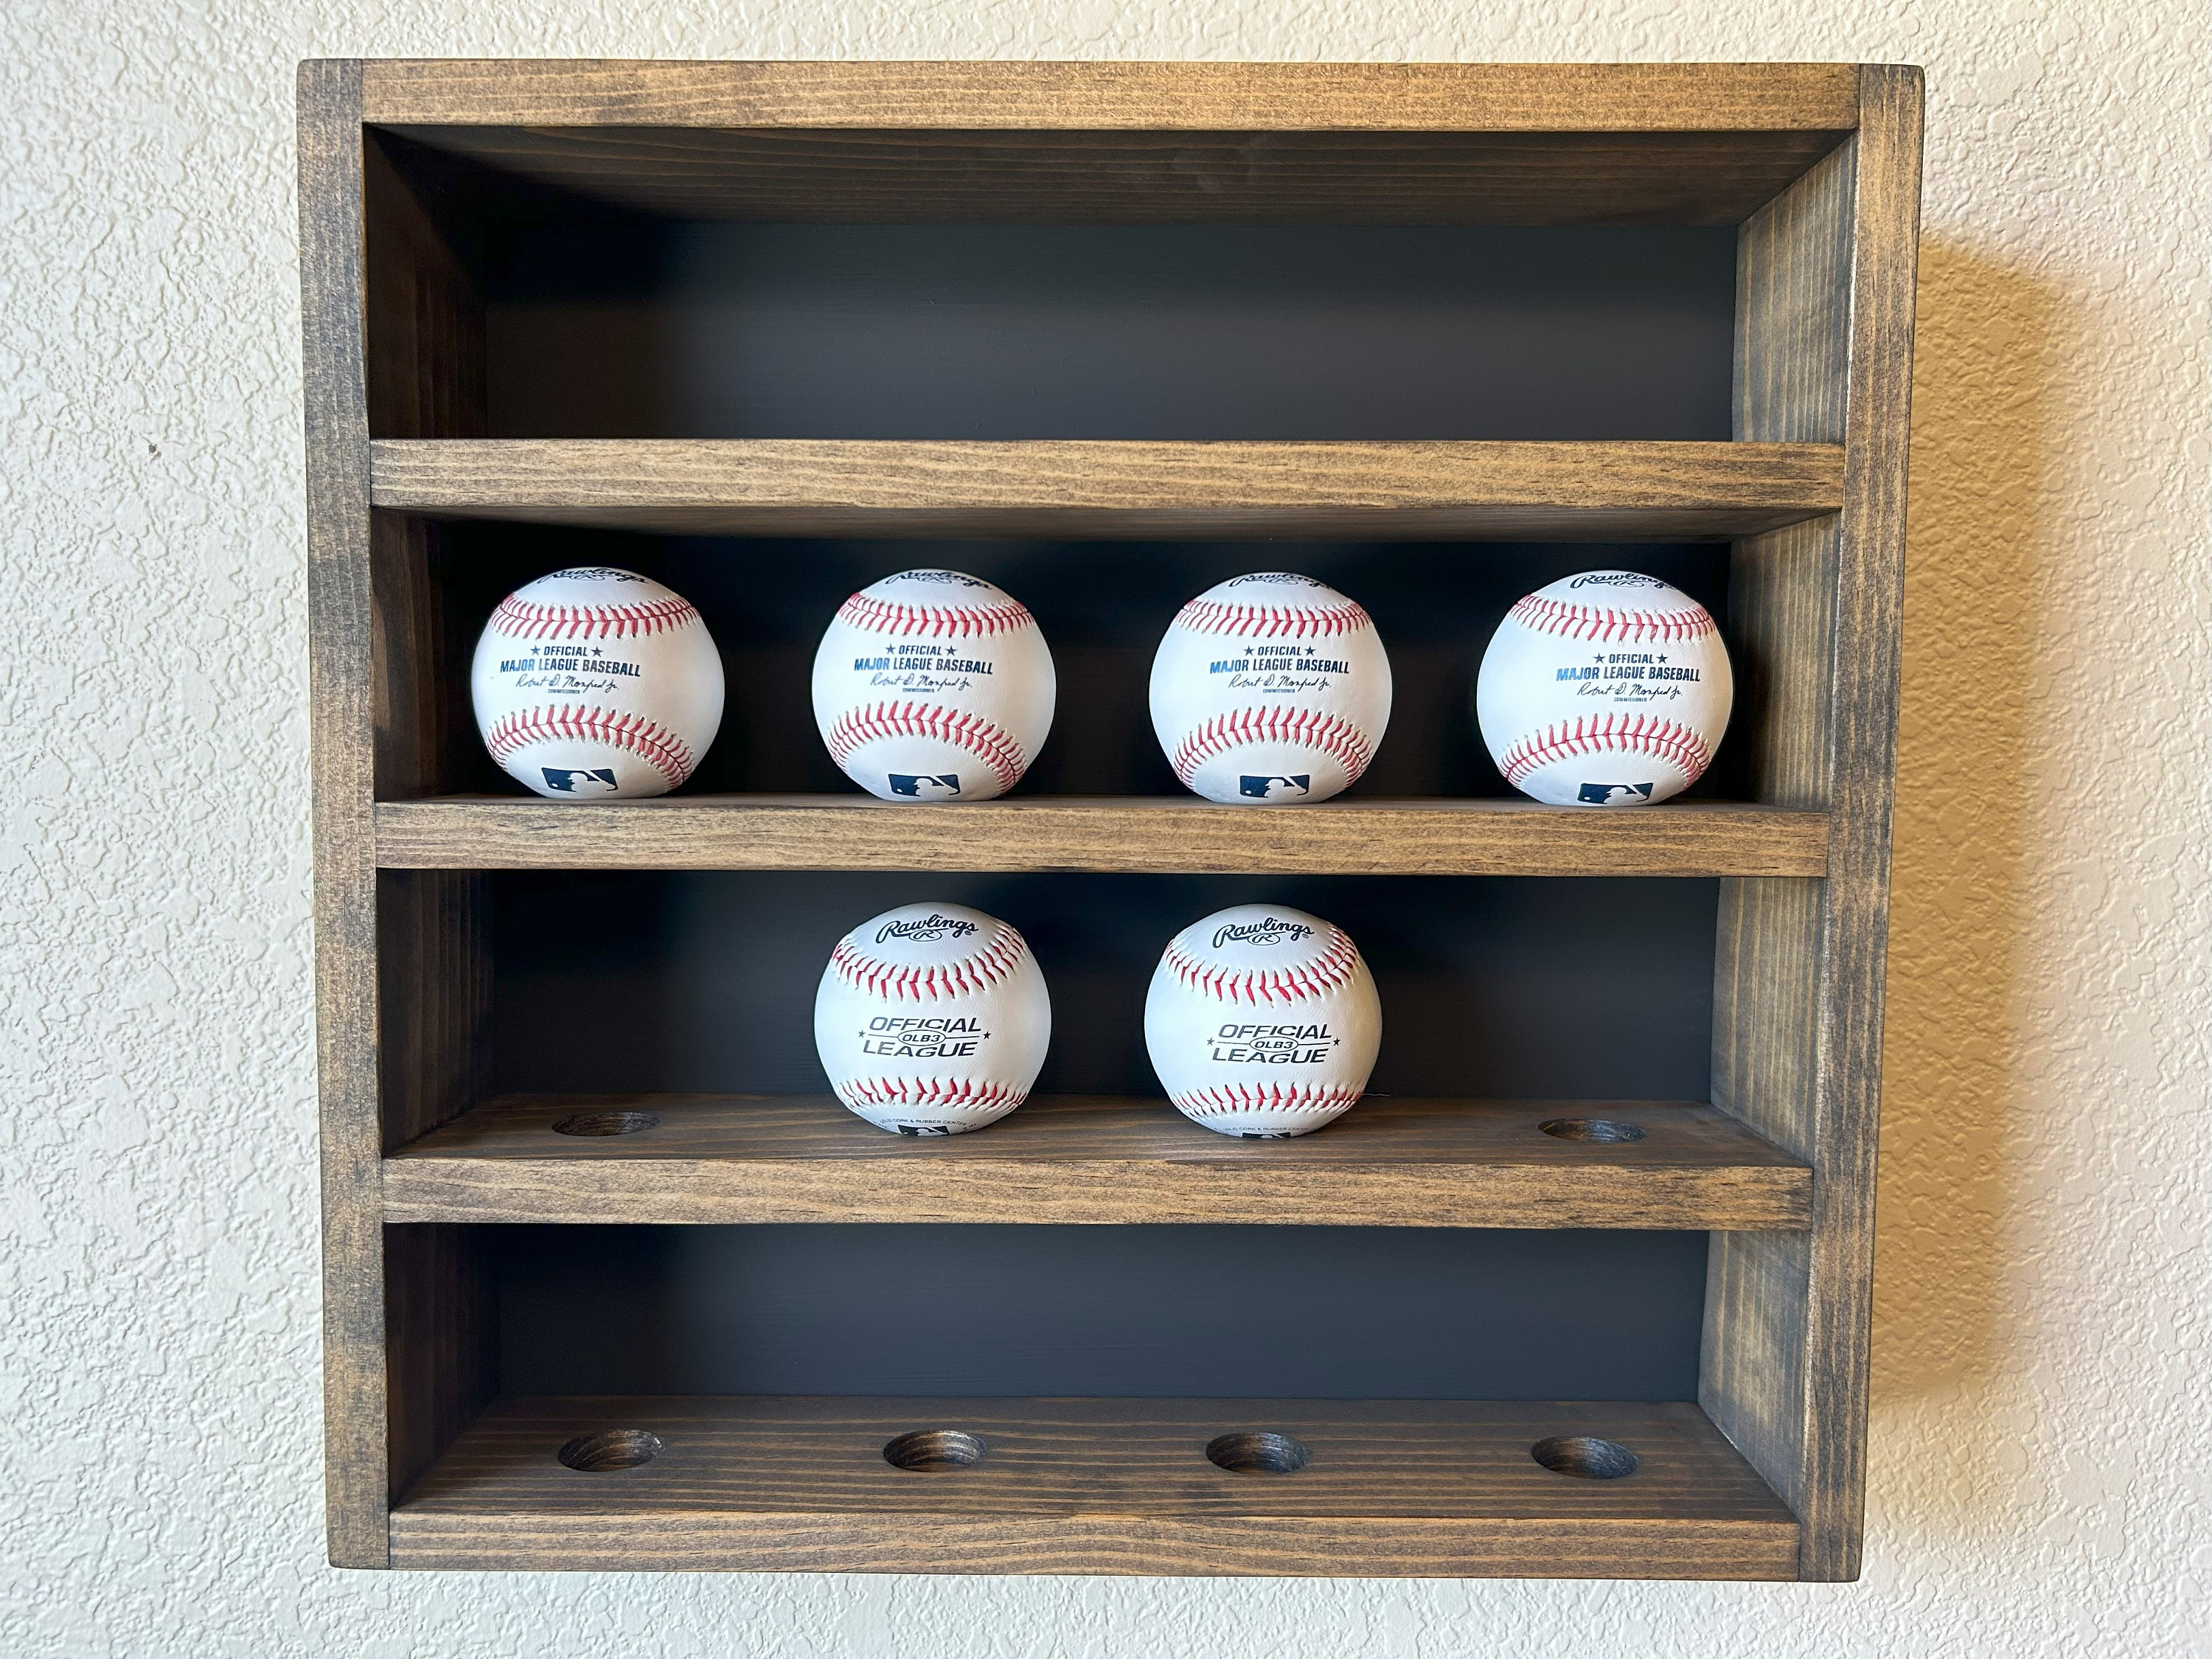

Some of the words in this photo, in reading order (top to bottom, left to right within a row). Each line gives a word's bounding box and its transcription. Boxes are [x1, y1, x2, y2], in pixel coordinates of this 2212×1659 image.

[543, 646, 588, 657] OFFICIAL
[898, 645, 942, 655] OFFICIAL
[1257, 646, 1301, 656] OFFICIAL
[1209, 659, 1249, 674] MAJOR
[1253, 658, 1293, 671] LEAGUE
[1296, 658, 1349, 674] BASEBALL
[1608, 653, 1654, 664] OFFICIAL
[500, 658, 535, 673] MAJOR
[538, 658, 579, 672] LEAGUE
[582, 659, 641, 678] BASEBALL
[854, 658, 890, 671] MAJOR
[893, 658, 933, 670] LEAGUE
[936, 658, 993, 675] BASEBALL
[1556, 667, 1600, 681] MAJOR
[1603, 667, 1645, 679] LEAGUE
[1649, 667, 1700, 682] BASEBALL
[876, 914, 978, 944] Rawlings
[1212, 917, 1314, 948] Rawlings
[869, 1017, 981, 1032] OFFICIAL
[1218, 1024, 1332, 1039] OFFICIAL
[902, 1034, 940, 1043] OLB3
[1254, 1040, 1293, 1049] OLB3
[863, 1040, 978, 1057] LEAGUE
[1212, 1047, 1329, 1064] LEAGUE
